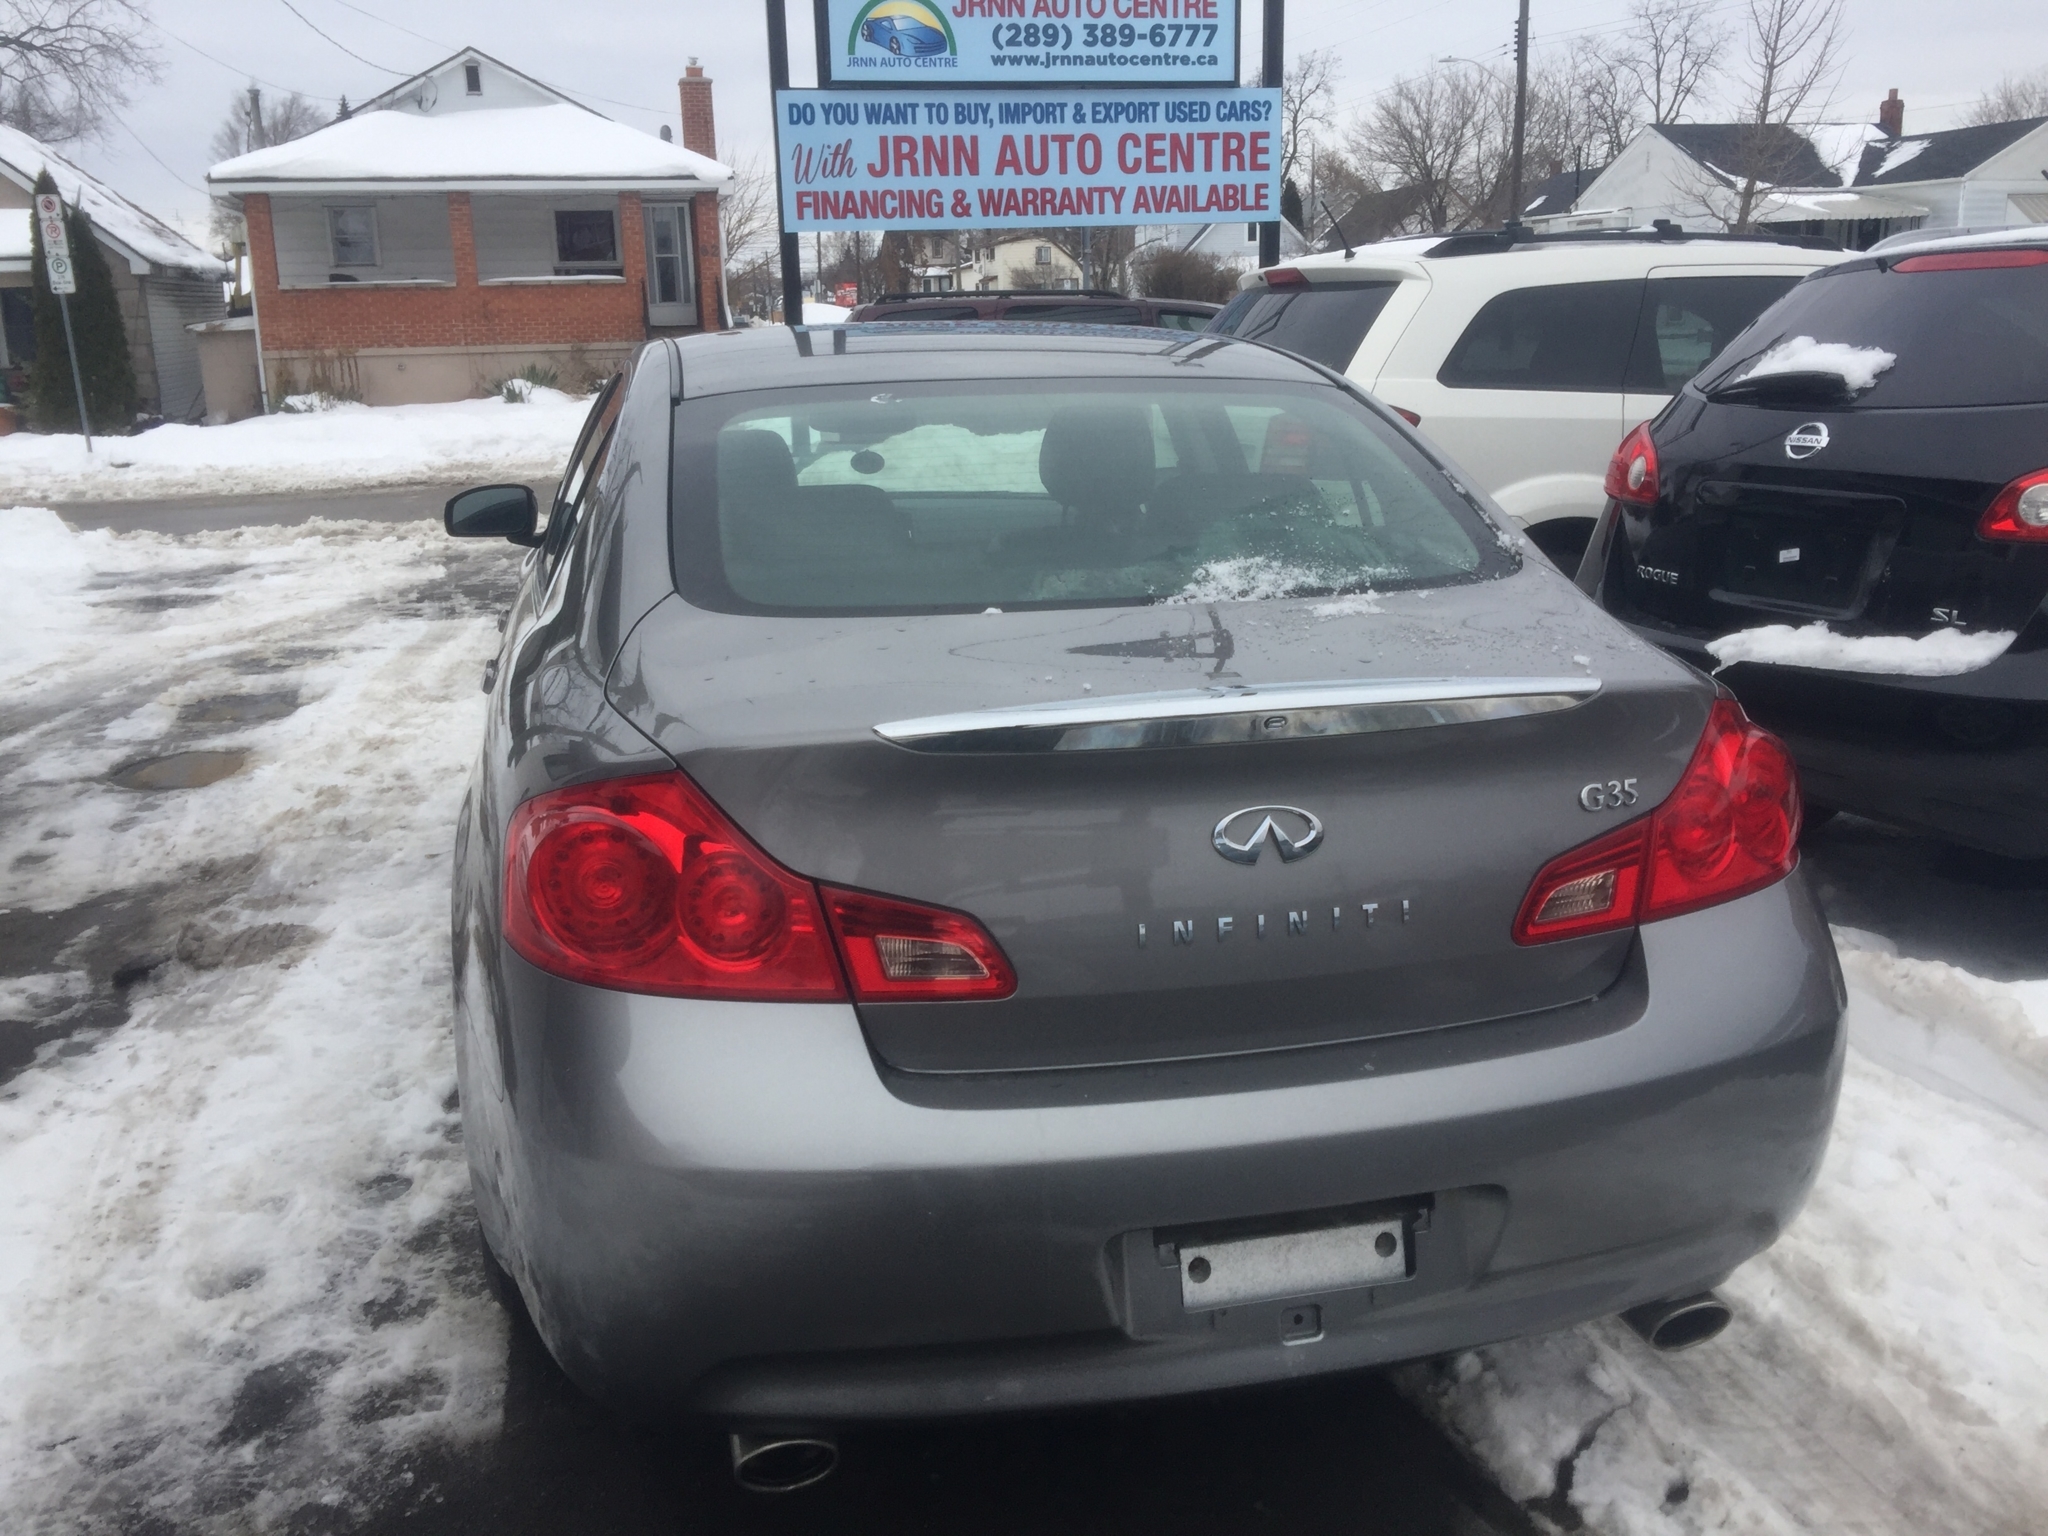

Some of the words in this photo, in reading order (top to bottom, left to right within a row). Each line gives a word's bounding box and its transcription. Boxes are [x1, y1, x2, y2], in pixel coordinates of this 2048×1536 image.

[952, 0, 1025, 18] JRNN
[1032, 0, 1103, 19] AUTO
[1113, 0, 1219, 19] CENTRE
[991, 23, 1073, 51] (289)
[1082, 23, 1219, 48] 389-6777
[846, 57, 877, 68] JRNN
[879, 57, 912, 68] AUTO
[914, 57, 959, 68] CENTRE
[990, 52, 1219, 69] www.jrnnautocentre.ca
[788, 102, 816, 126] DO
[820, 102, 859, 125] YOU
[863, 102, 920, 125] WANT
[924, 102, 949, 125] TO
[954, 102, 994, 129] BUY,
[998, 102, 1068, 125] IMPORT
[1072, 102, 1087, 124] &
[1091, 101, 1160, 124] EXPORT
[1165, 100, 1211, 123] USED
[1215, 100, 1272, 122] CARS?
[791, 138, 858, 185] With
[867, 134, 980, 178] JRNN
[995, 132, 1103, 176] AUTO
[1117, 131, 1271, 175] CENTRE
[796, 188, 945, 221] FINANCING
[950, 188, 972, 218] &
[977, 186, 1127, 217] WARRANTY
[1132, 183, 1270, 214] AVAILABLE
[1788, 436, 1823, 445] NISSAN
[1636, 564, 1679, 585] ROGUE
[1930, 607, 1967, 625] SL
[1579, 778, 1639, 812] G35
[1137, 899, 1410, 948] INFINITI
